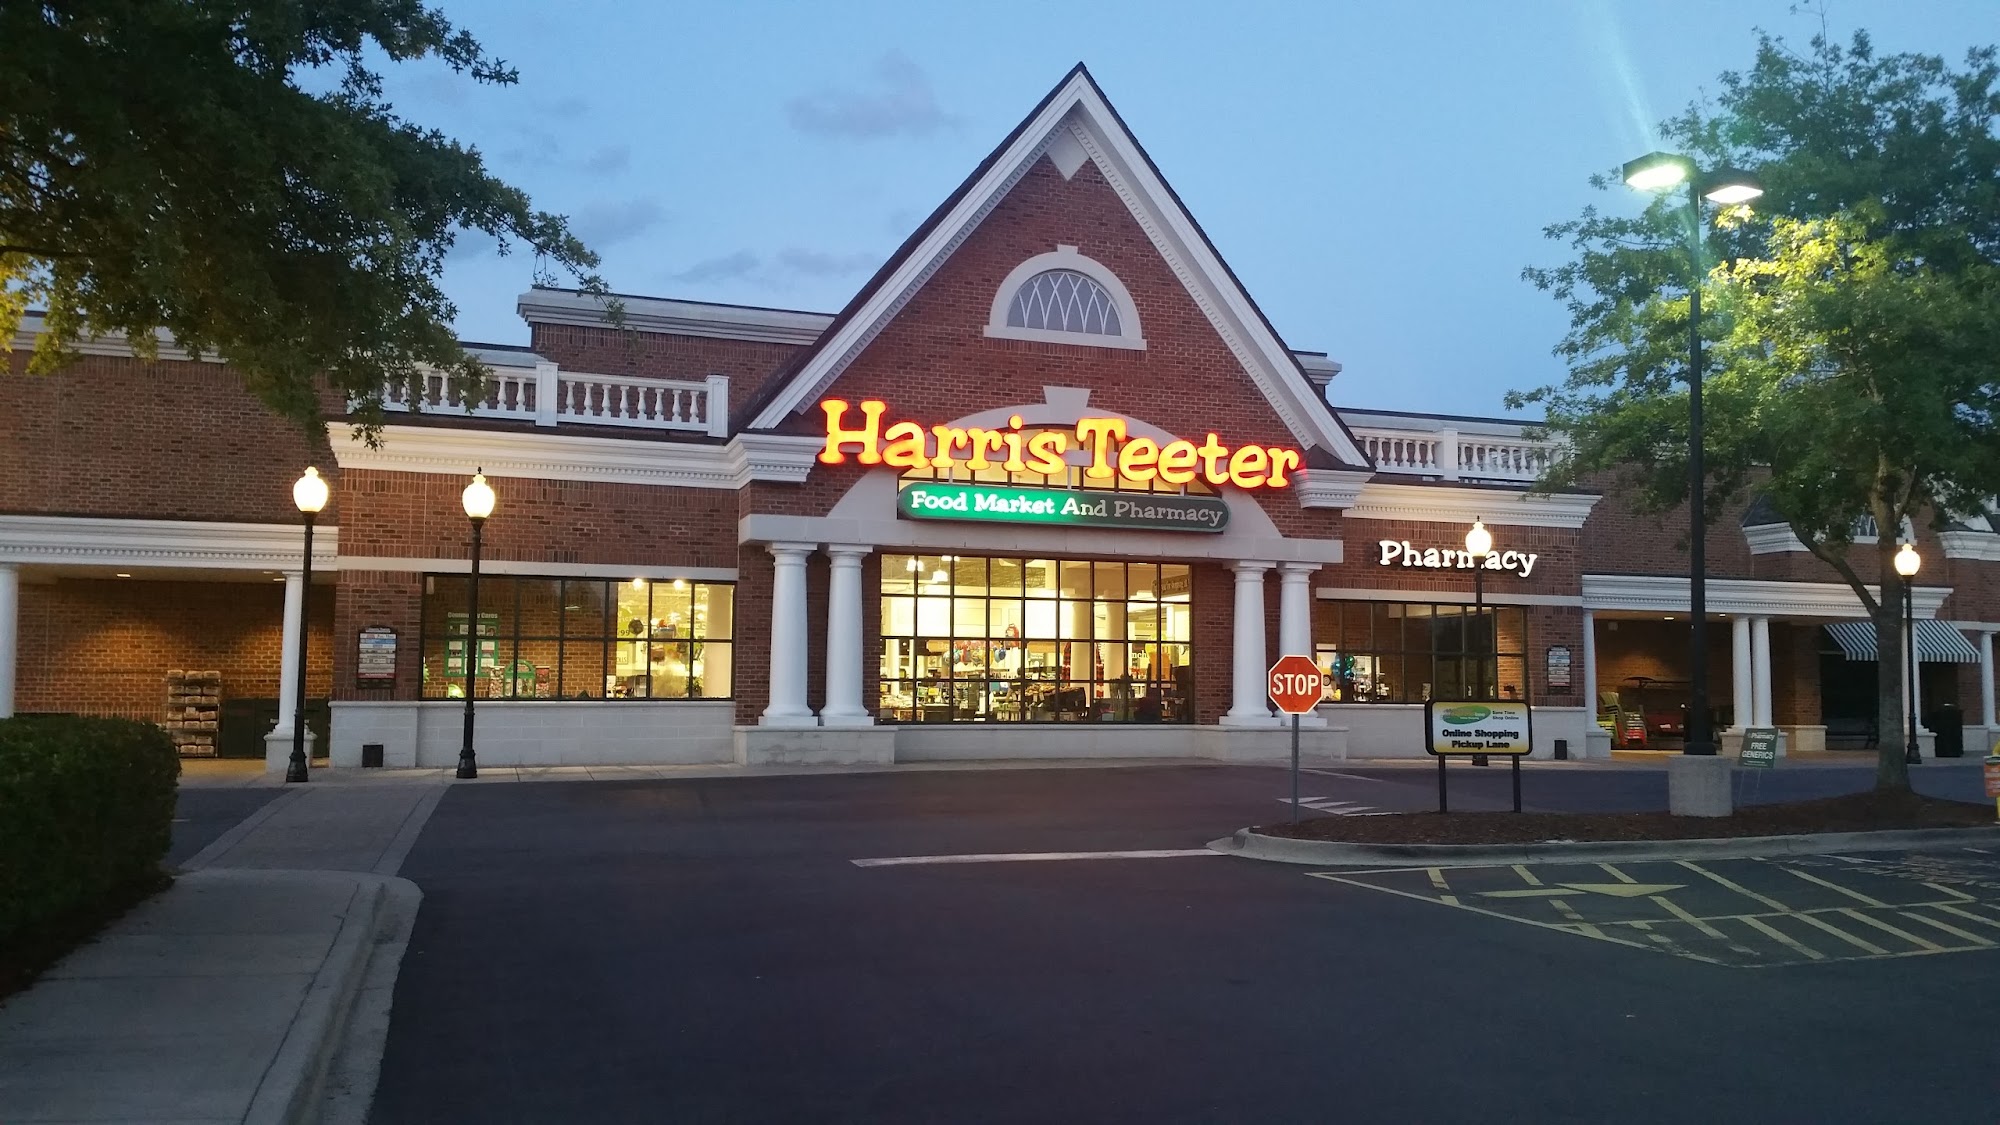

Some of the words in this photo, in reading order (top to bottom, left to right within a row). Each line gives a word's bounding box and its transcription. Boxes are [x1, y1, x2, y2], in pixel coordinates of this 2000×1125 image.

[818, 399, 1067, 474] Harris
[1076, 418, 1299, 488] Teeter
[911, 490, 968, 511] Food
[974, 493, 1055, 514] Market
[1060, 497, 1107, 517] And
[1114, 500, 1223, 527] Pharmacy
[1272, 673, 1319, 696] STOP
[1442, 729, 1472, 738] Online
[1474, 729, 1519, 740] Shopping
[1451, 740, 1484, 750] Pickup
[1486, 740, 1510, 749] Lane
[1751, 742, 1767, 750] FREE
[1742, 750, 1774, 759] GENERICS
